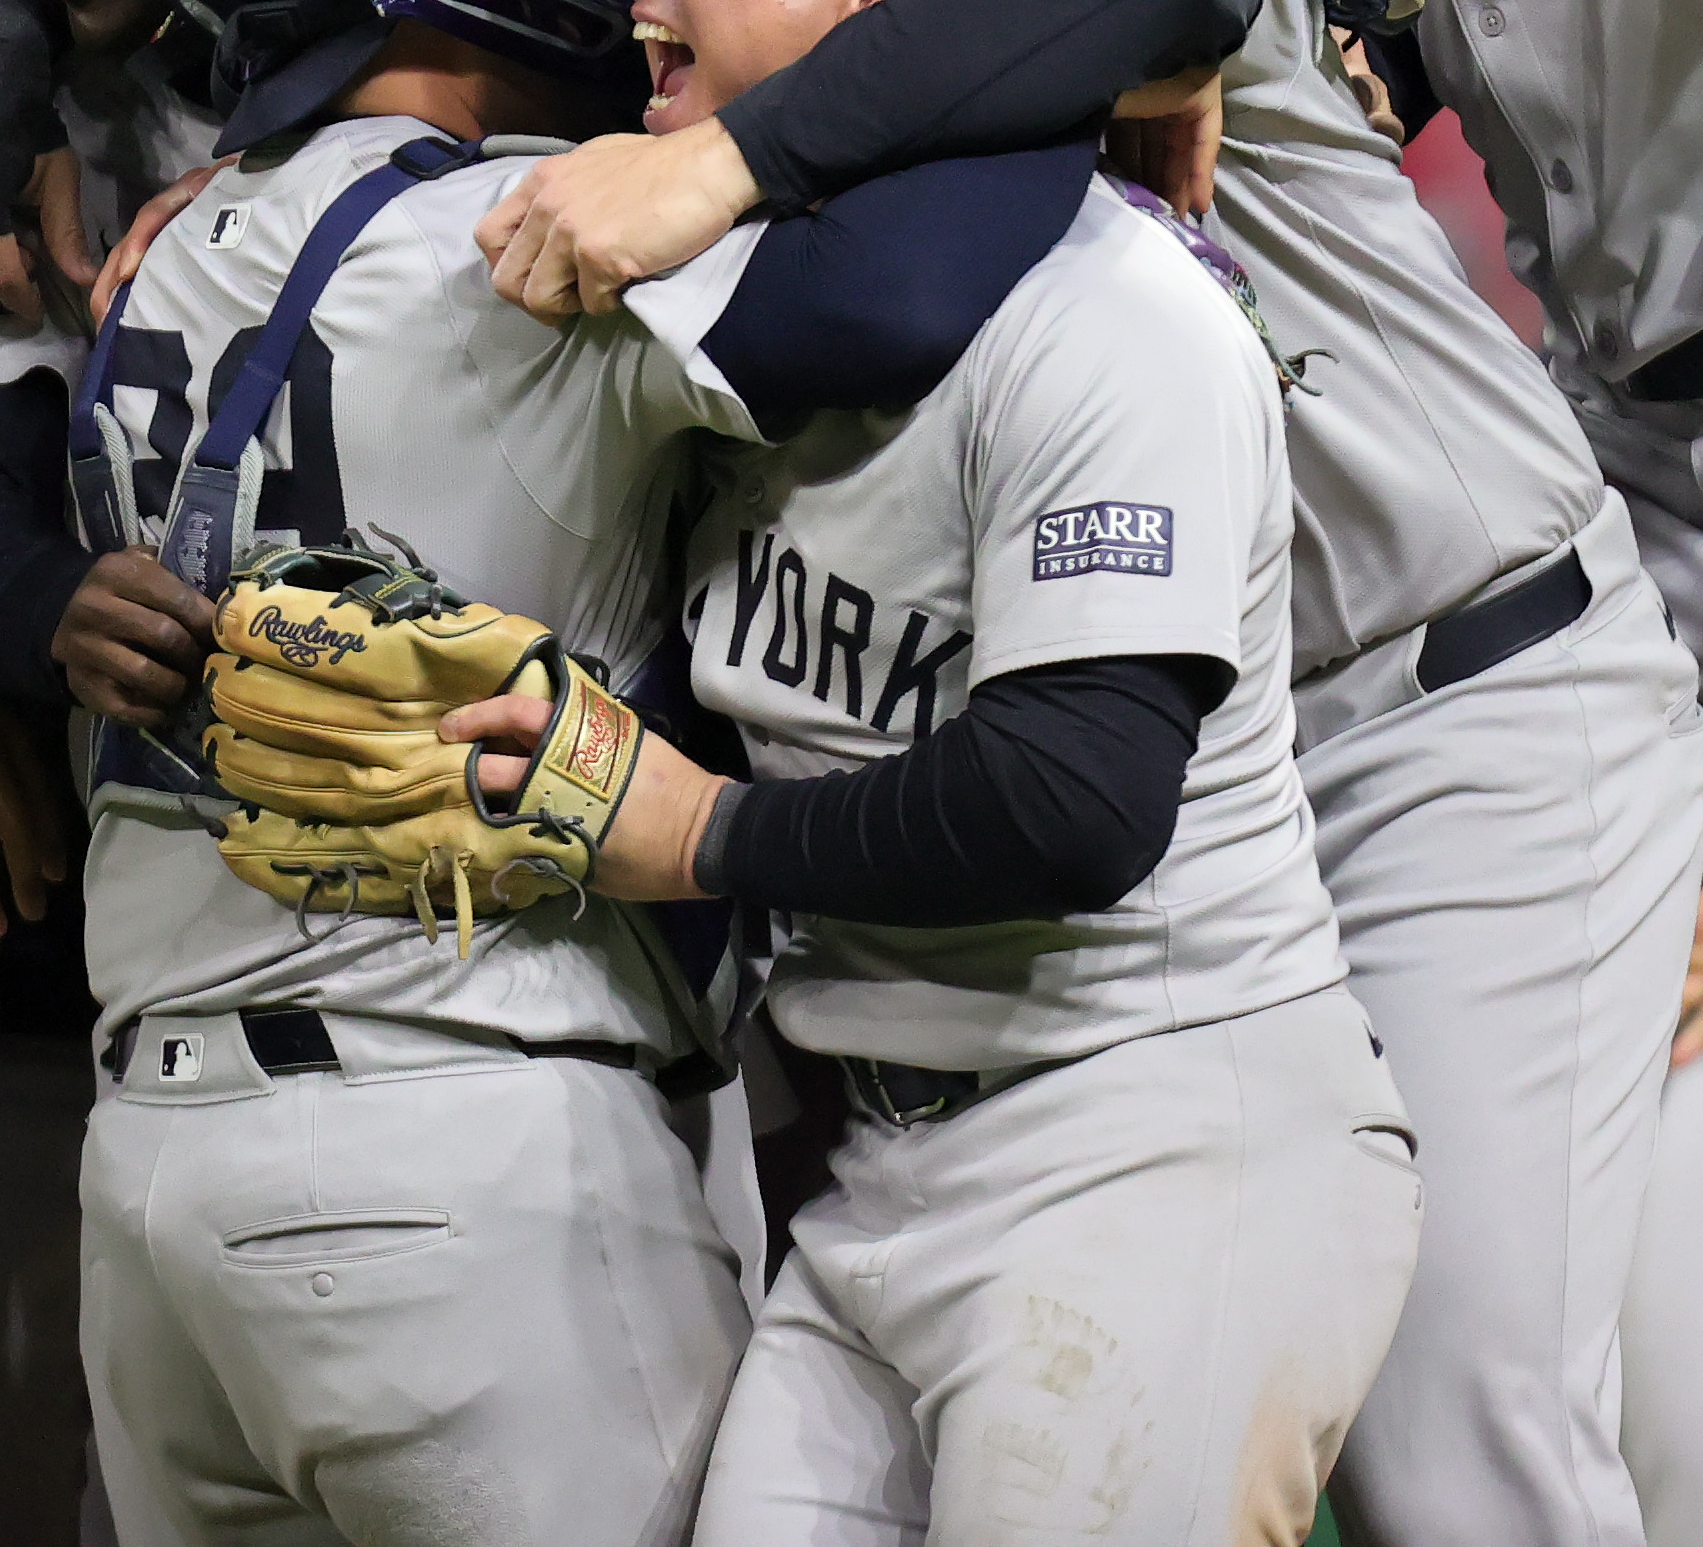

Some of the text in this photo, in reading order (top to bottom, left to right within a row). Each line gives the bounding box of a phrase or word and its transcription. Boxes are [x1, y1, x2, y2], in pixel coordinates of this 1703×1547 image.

[1037, 506, 1168, 550] STARR
[1038, 551, 1165, 575] INSURANCE
[249, 605, 368, 667] Rawlings
[726, 529, 975, 743] YORK
